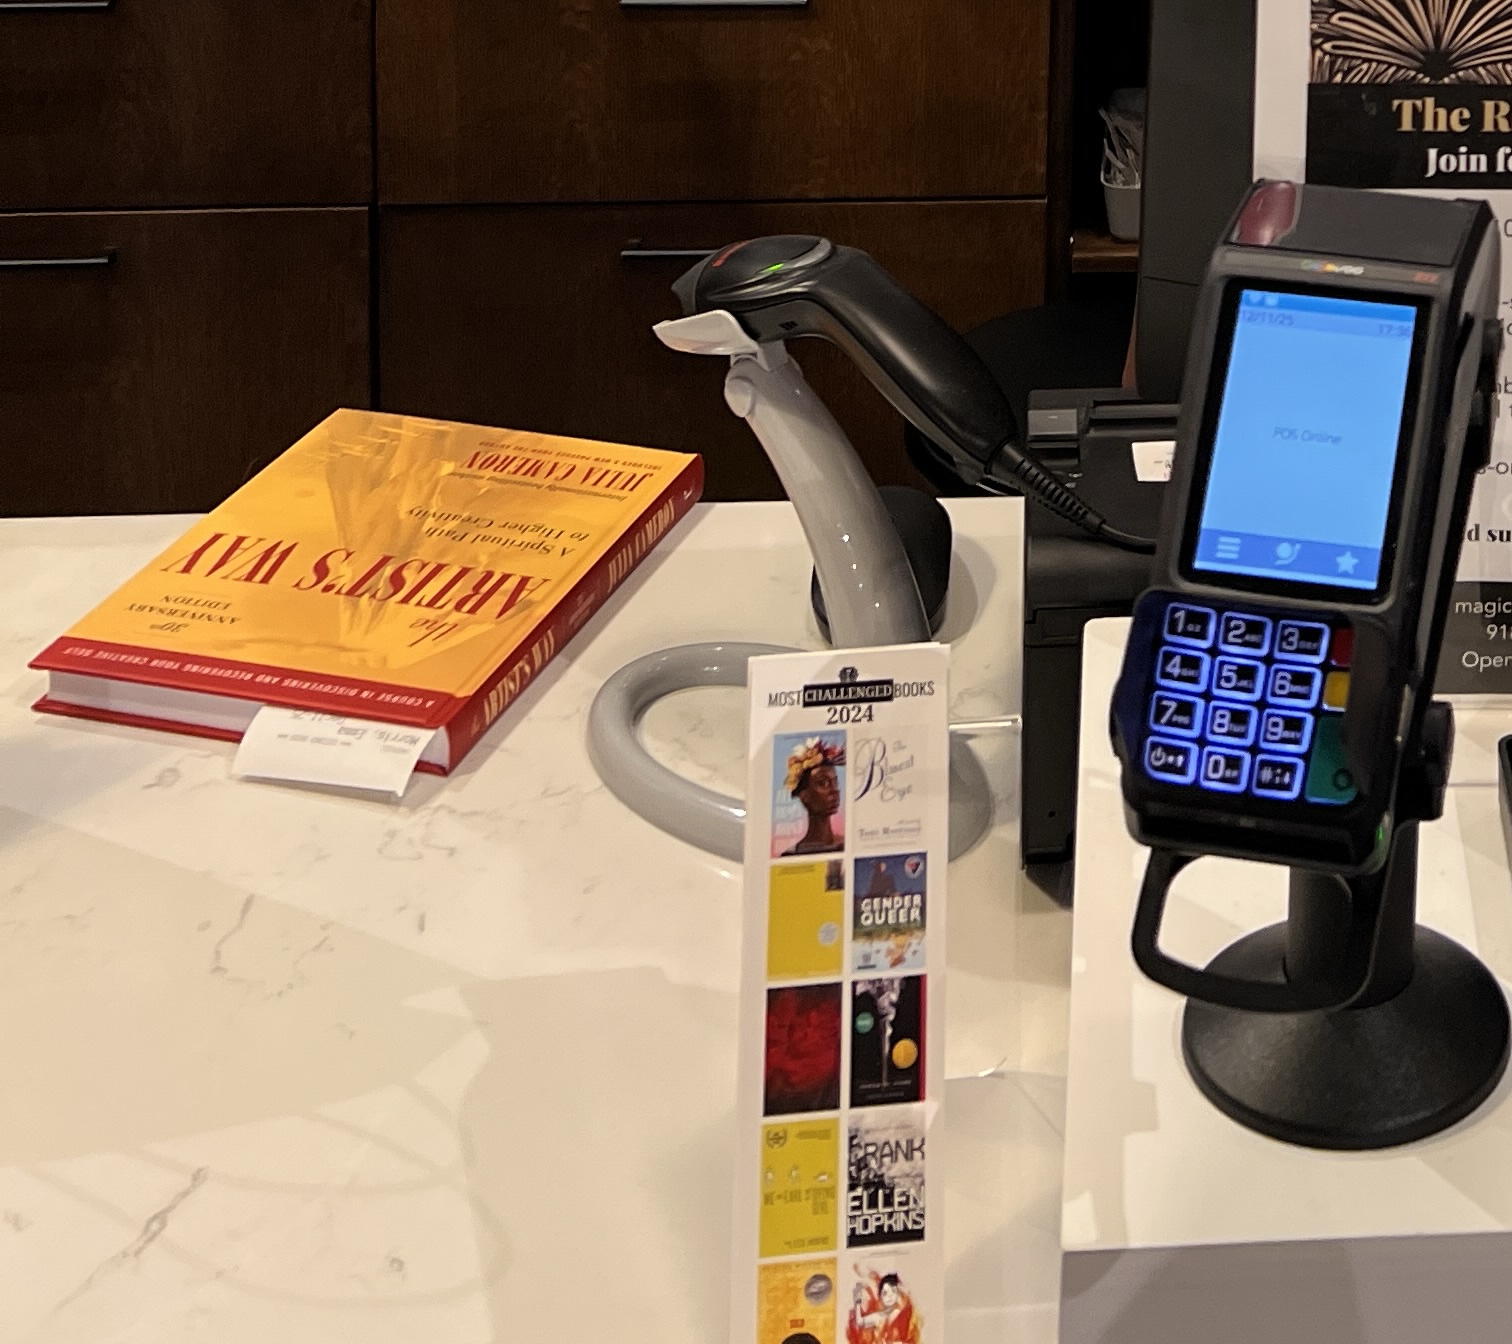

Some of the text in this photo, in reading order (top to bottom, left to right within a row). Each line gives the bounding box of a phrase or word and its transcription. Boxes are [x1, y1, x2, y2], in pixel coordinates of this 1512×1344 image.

[1392, 97, 1471, 133] The
[1425, 145, 1488, 178] Join
[465, 450, 654, 492] JULIA CAMERON
[425, 526, 551, 555] Spiritual Path
[162, 532, 552, 620] ARTIST'S WAY
[409, 617, 460, 648] the
[768, 681, 935, 708] MOST CHALLENGED BOOKS
[826, 705, 875, 725] 2024
[861, 894, 922, 912] GENDER
[860, 910, 921, 926] QUEER
[847, 1186, 925, 1216] ELLEN
[847, 1211, 925, 1236] HOPKINS
